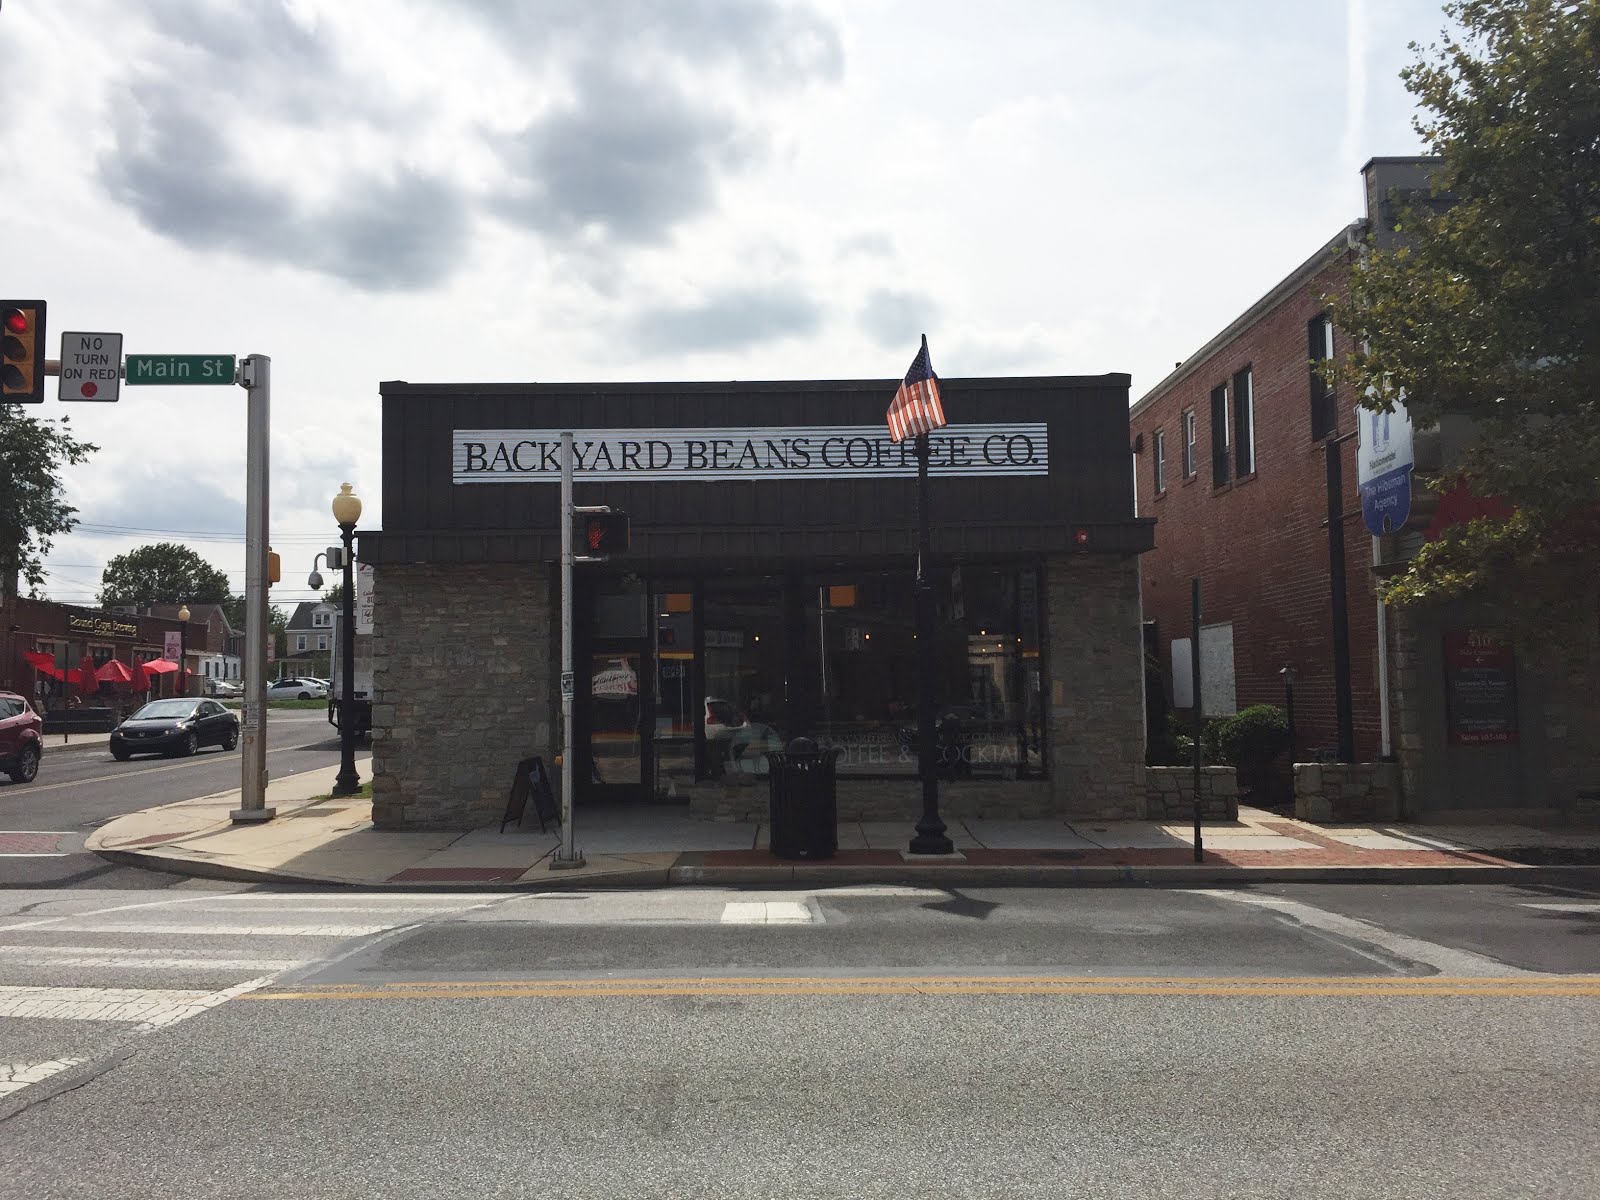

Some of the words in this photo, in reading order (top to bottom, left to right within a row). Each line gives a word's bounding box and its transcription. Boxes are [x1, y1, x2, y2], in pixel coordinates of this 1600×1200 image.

[80, 337, 103, 350] NO
[74, 353, 109, 365] TURN
[63, 368, 83, 380] ON
[89, 368, 116, 380] RED
[137, 358, 190, 377] Main
[201, 359, 223, 377] St
[462, 440, 673, 472] BACKYARD
[683, 438, 811, 470] BEANS
[820, 436, 973, 469] COFFEE
[982, 434, 1040, 466] CO.
[1365, 485, 1377, 498] The
[1374, 494, 1398, 512] Agency
[898, 744, 912, 764] &
